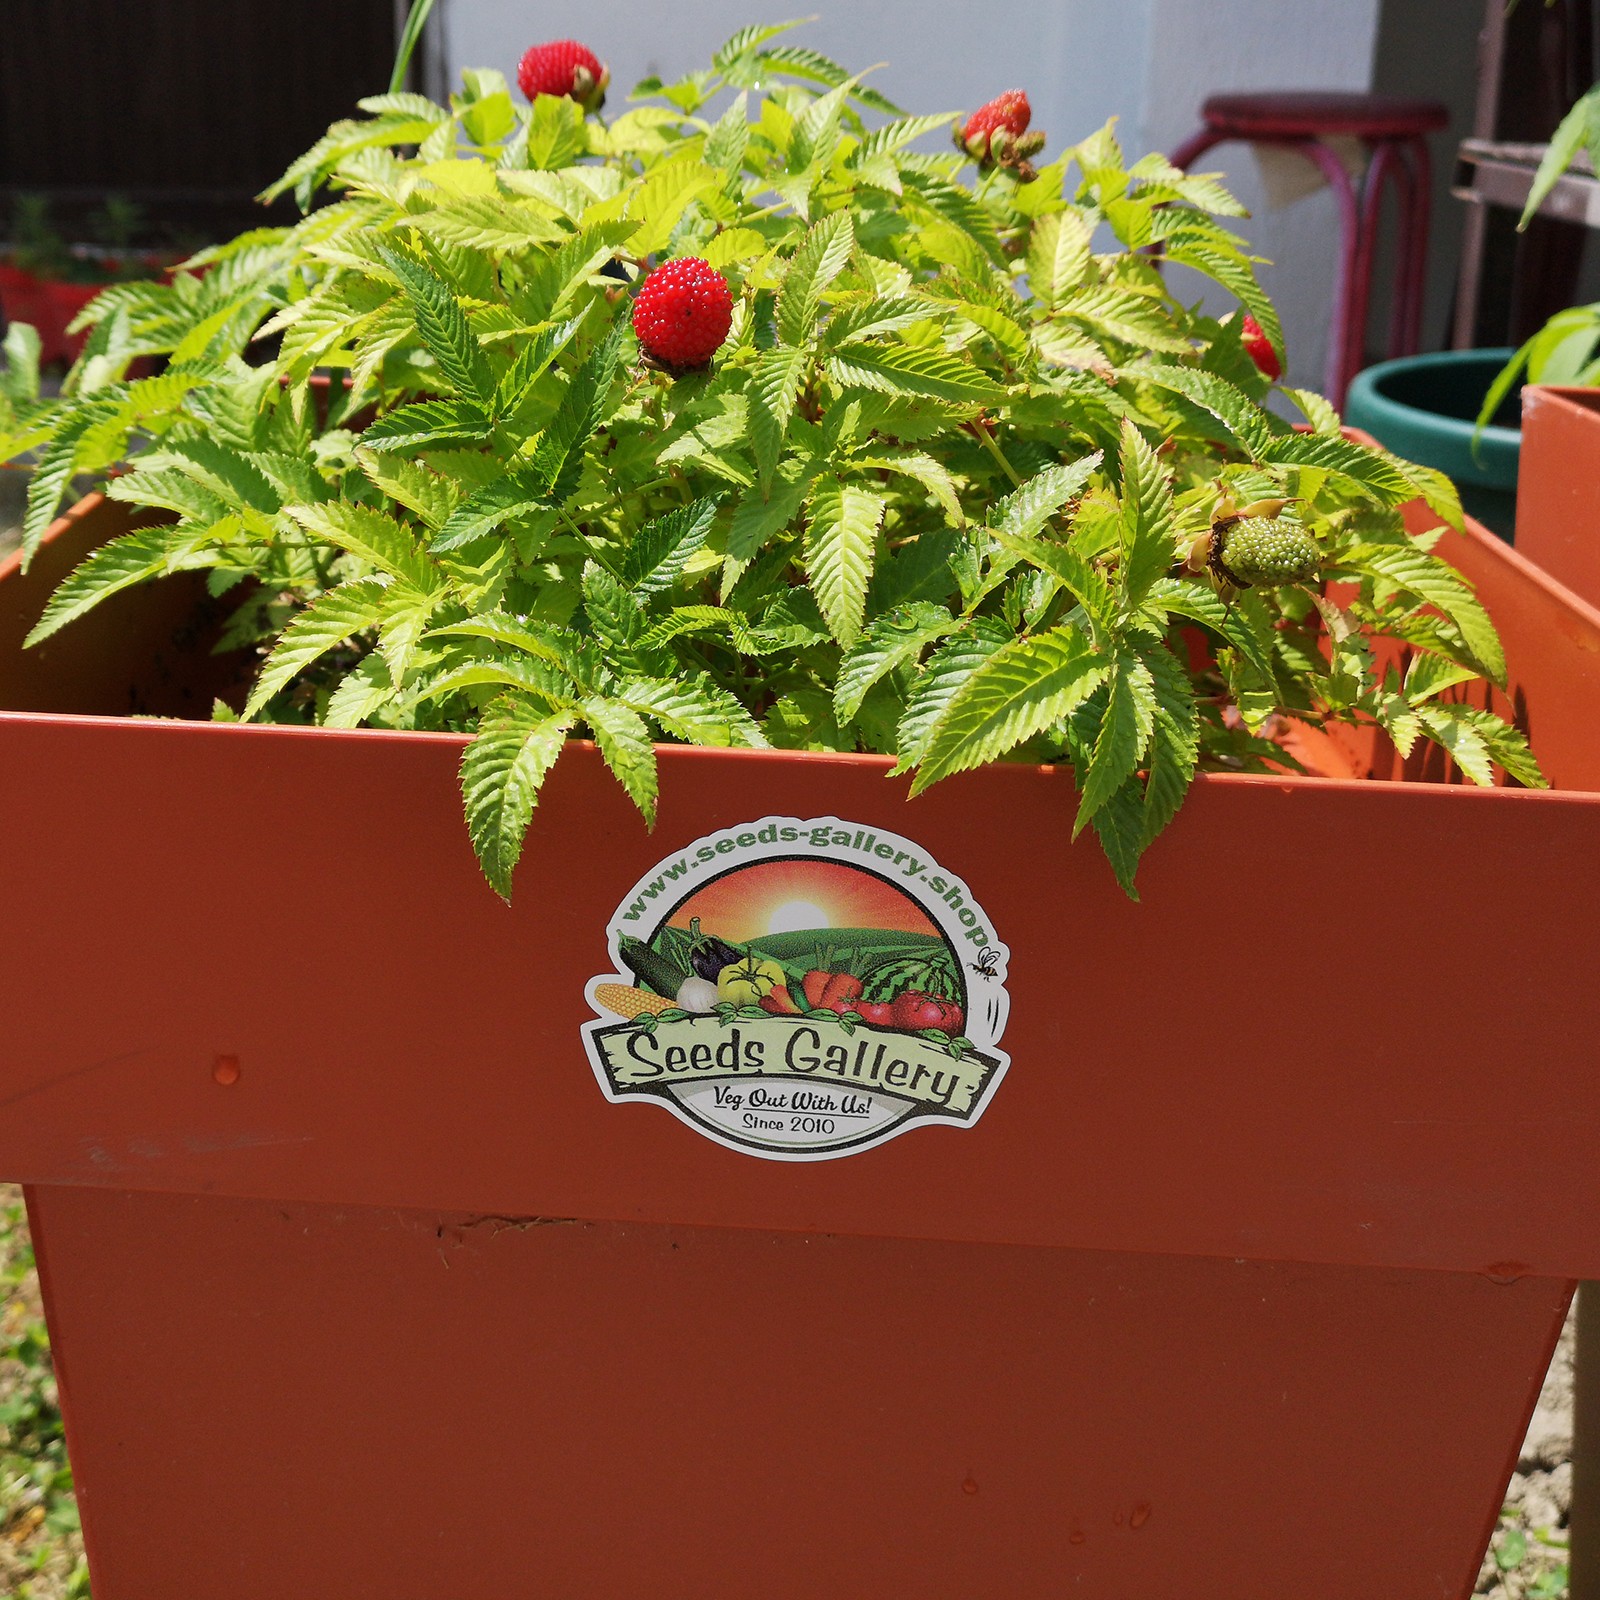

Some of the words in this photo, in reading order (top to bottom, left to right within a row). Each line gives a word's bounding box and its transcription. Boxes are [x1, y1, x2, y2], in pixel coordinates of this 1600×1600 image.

[623, 824, 989, 948] www.seeds-gallery.shop
[627, 1029, 765, 1077] Seeds
[785, 1028, 959, 1098] Gallery
[713, 1086, 745, 1110] Veg
[748, 1088, 788, 1110] Out
[790, 1091, 838, 1112] With
[841, 1095, 872, 1114] Us!
[742, 1114, 785, 1132] Since
[790, 1117, 836, 1135] 2010
